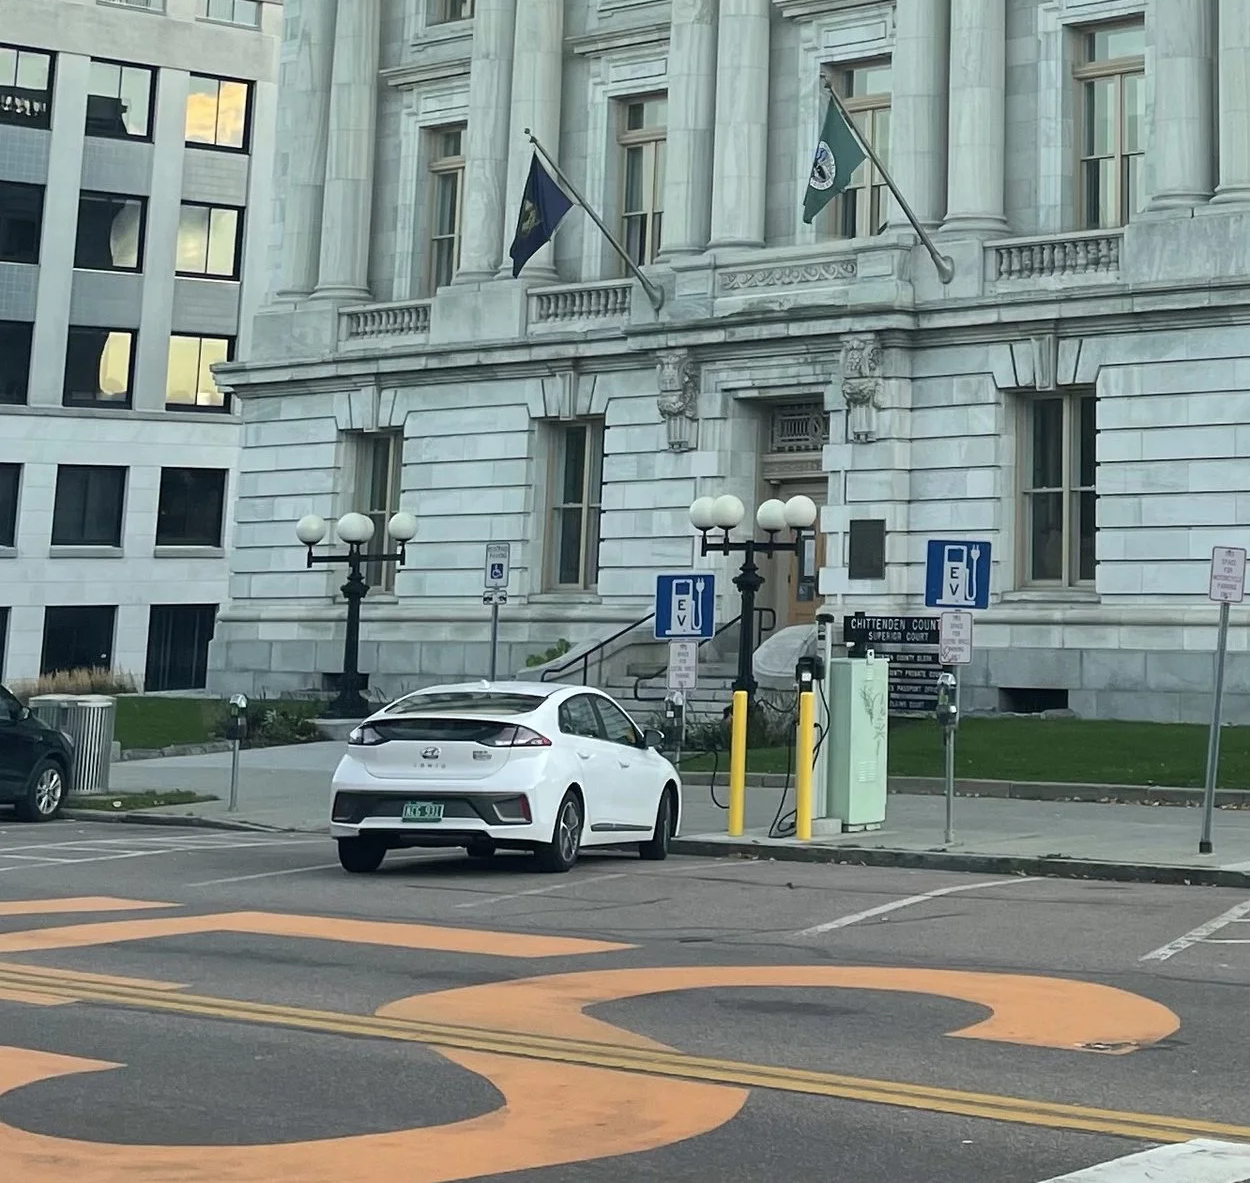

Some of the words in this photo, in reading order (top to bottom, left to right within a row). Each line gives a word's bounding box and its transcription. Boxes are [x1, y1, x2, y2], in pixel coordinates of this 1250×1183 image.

[949, 567, 960, 596] EV
[676, 599, 687, 626] EV
[850, 618, 906, 630] CHITTENDEN
[912, 618, 940, 631] COUNT
[868, 631, 902, 641] SUPERIOR
[906, 632, 929, 641] COURT
